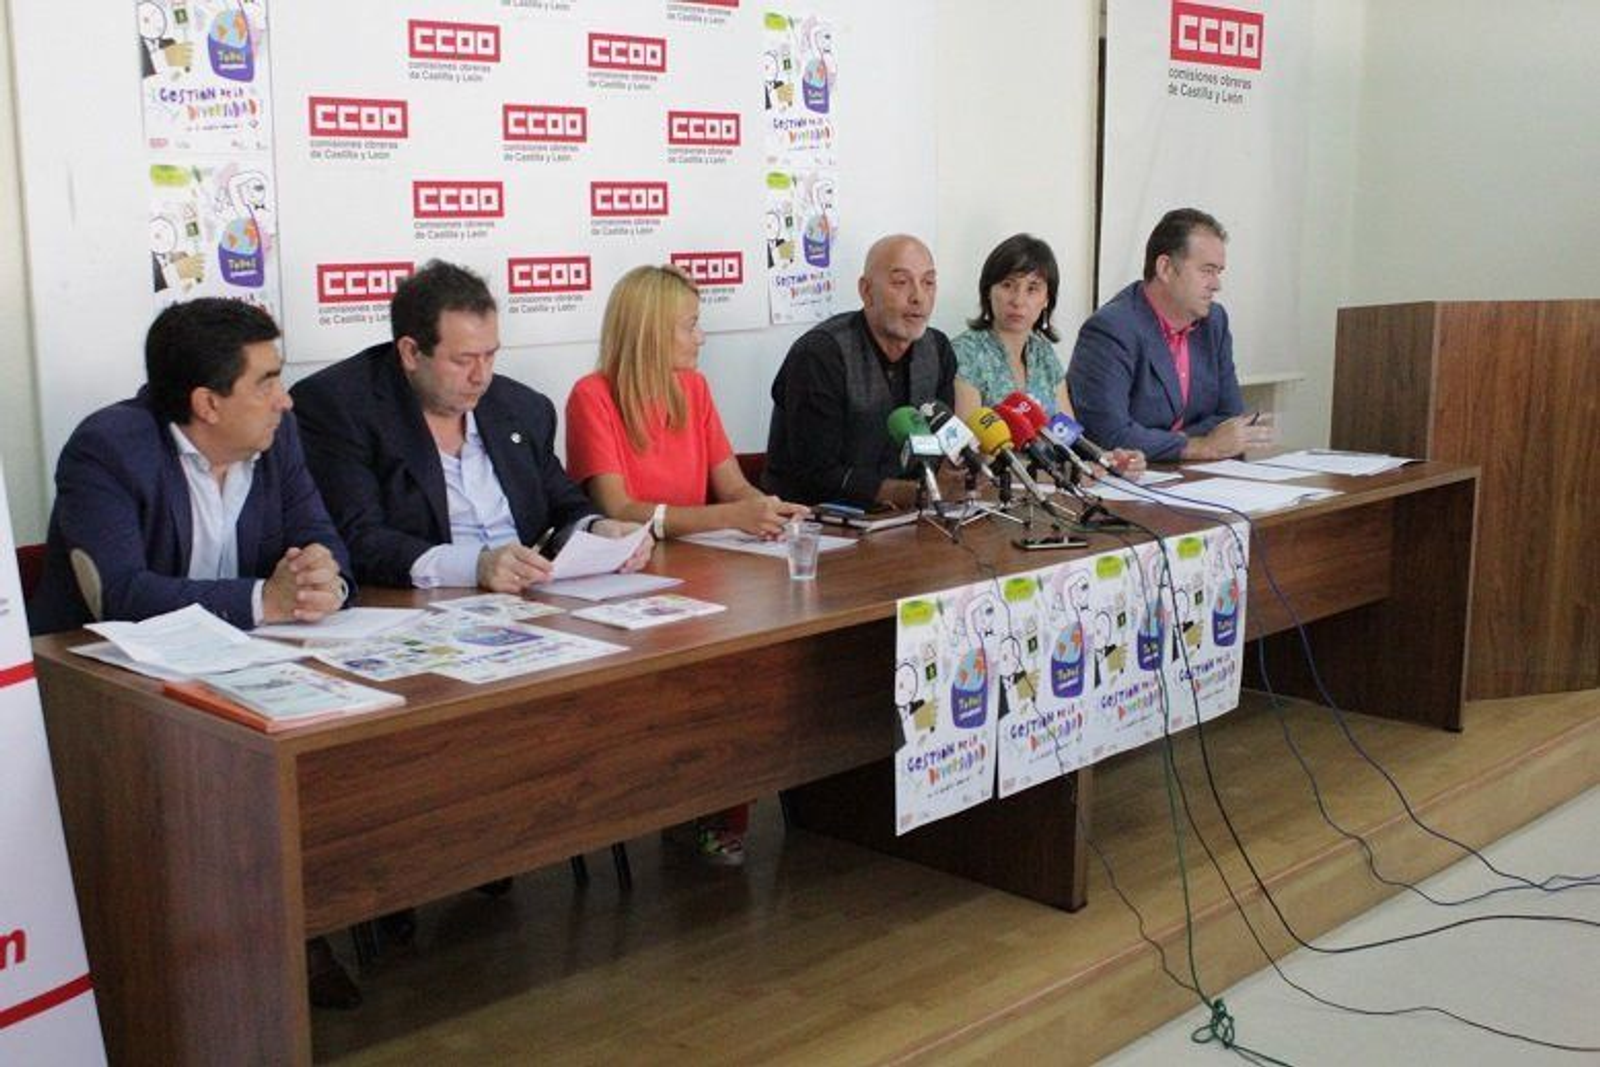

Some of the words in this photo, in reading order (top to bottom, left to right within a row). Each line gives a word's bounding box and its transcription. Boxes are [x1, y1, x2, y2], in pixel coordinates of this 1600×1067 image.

[414, 27, 495, 55] CCOO
[1178, 14, 1259, 58] CCOO
[592, 39, 662, 65] CCOO
[1168, 82, 1178, 96] de
[1180, 83, 1213, 100] Castilla
[315, 104, 403, 131] CCOO
[507, 111, 582, 137] CCOO
[672, 117, 737, 140] CCOO
[418, 188, 499, 212] CCOO
[595, 189, 664, 210] CCOO
[513, 263, 587, 287] CCOO
